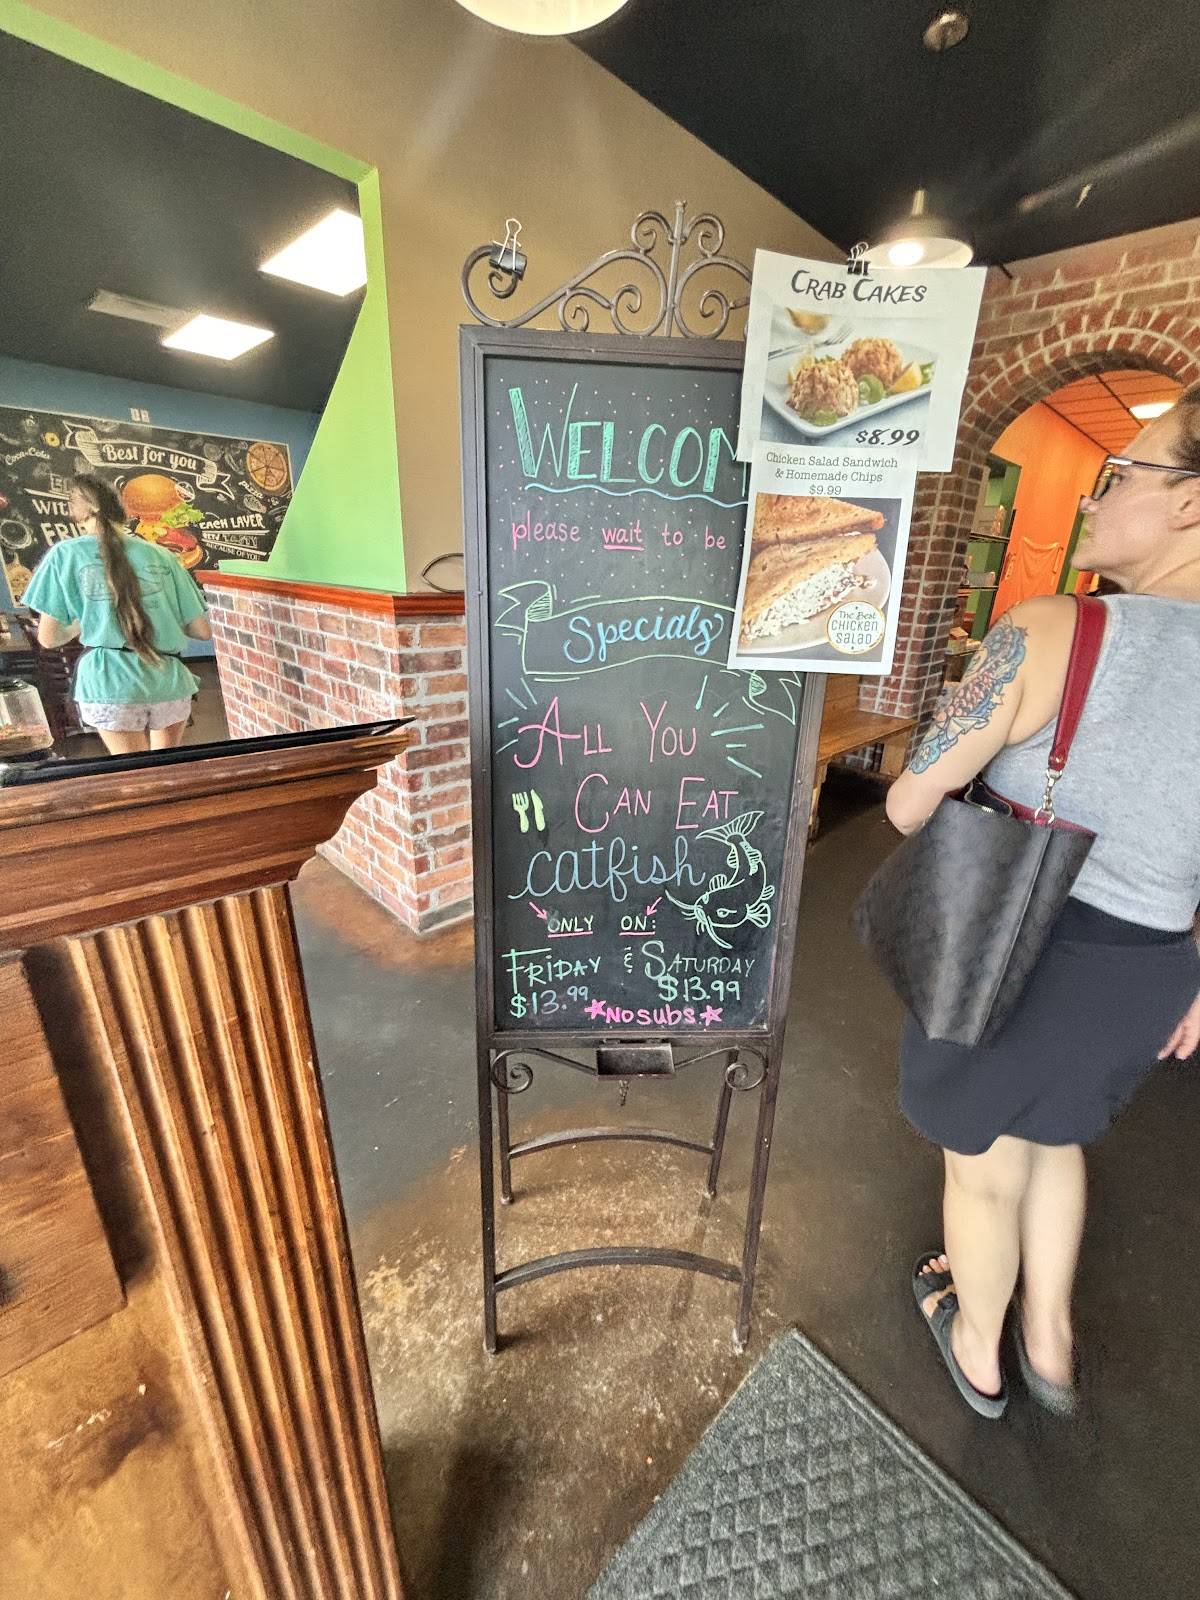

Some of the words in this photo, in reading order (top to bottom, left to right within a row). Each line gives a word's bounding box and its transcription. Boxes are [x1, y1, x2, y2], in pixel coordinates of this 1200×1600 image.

[791, 270, 846, 300] CRAB
[853, 278, 927, 304] CAKES
[508, 383, 746, 497] WELCOM
[855, 428, 920, 446] $8.99
[103, 444, 137, 462] Best
[142, 444, 166, 465] for
[170, 454, 197, 471] you
[766, 452, 806, 466] Chicken
[808, 456, 839, 467] Salad
[842, 456, 898, 468] Sandwich
[775, 468, 784, 479] &
[786, 470, 848, 482] Homemade
[851, 471, 883, 483] Chips
[809, 485, 842, 496] $9.99
[230, 513, 266, 529] LAYER
[512, 510, 581, 550] please
[602, 520, 644, 545] wait
[662, 522, 683, 547] to
[705, 525, 727, 550] be
[563, 605, 724, 663] Specials
[575, 773, 652, 833] CAN
[676, 777, 739, 829] EAT
[508, 836, 706, 901] catfish
[547, 915, 594, 933] ONLY
[641, 940, 756, 981] SATURDAY
[510, 985, 589, 1018] $13.99
[658, 975, 741, 1002] $13.99
